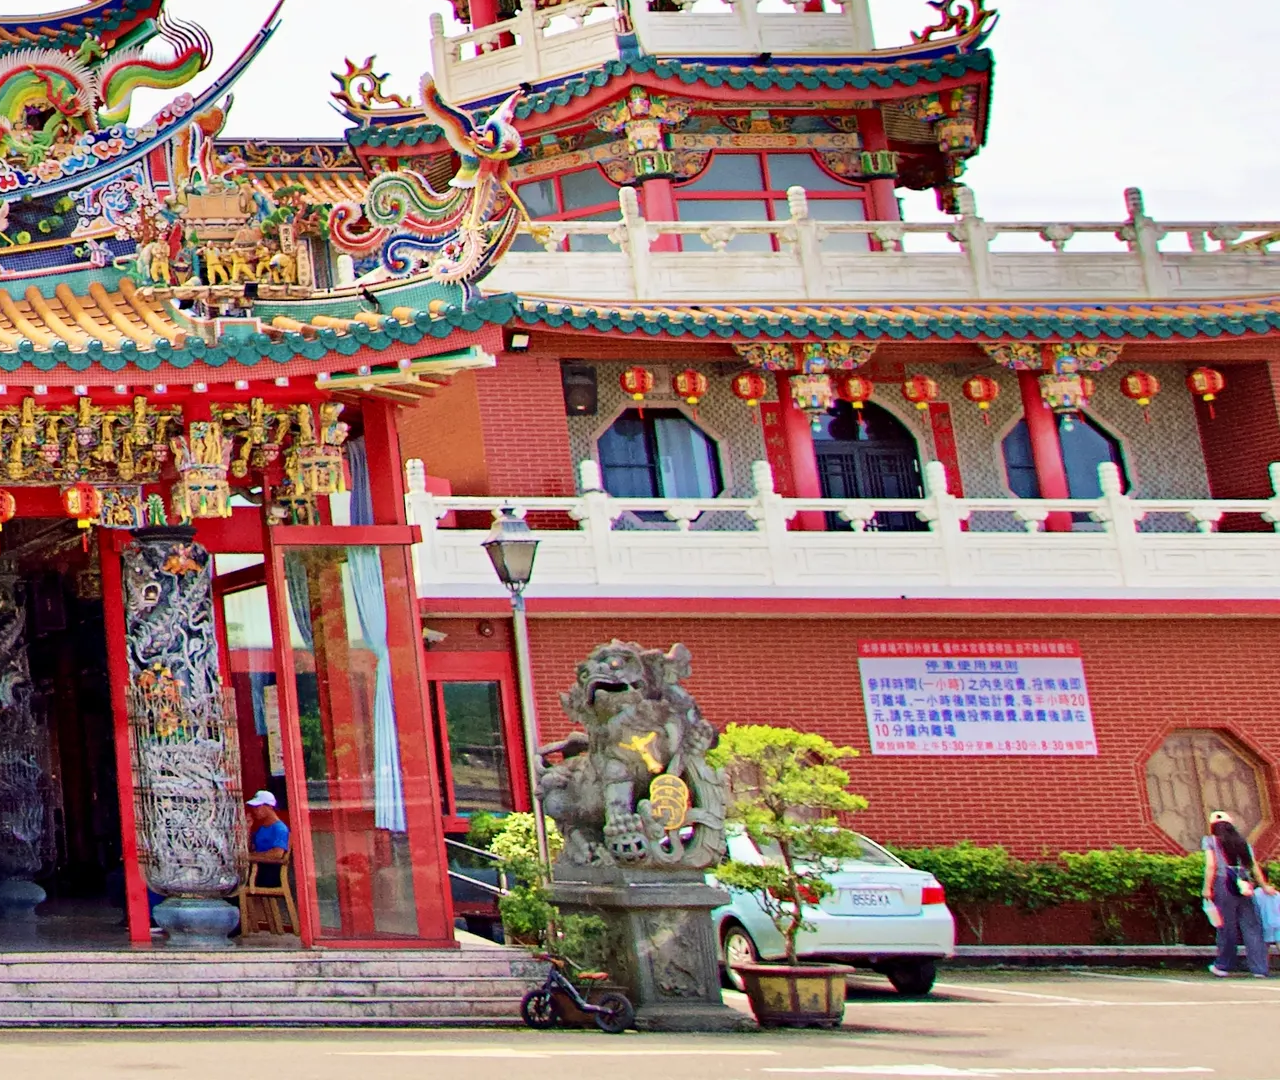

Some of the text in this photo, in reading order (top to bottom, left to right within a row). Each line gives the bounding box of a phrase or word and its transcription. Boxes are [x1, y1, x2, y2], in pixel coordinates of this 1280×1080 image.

[925, 659, 1019, 671] 停車使用規則
[875, 724, 957, 738] 10分鐘內離場
